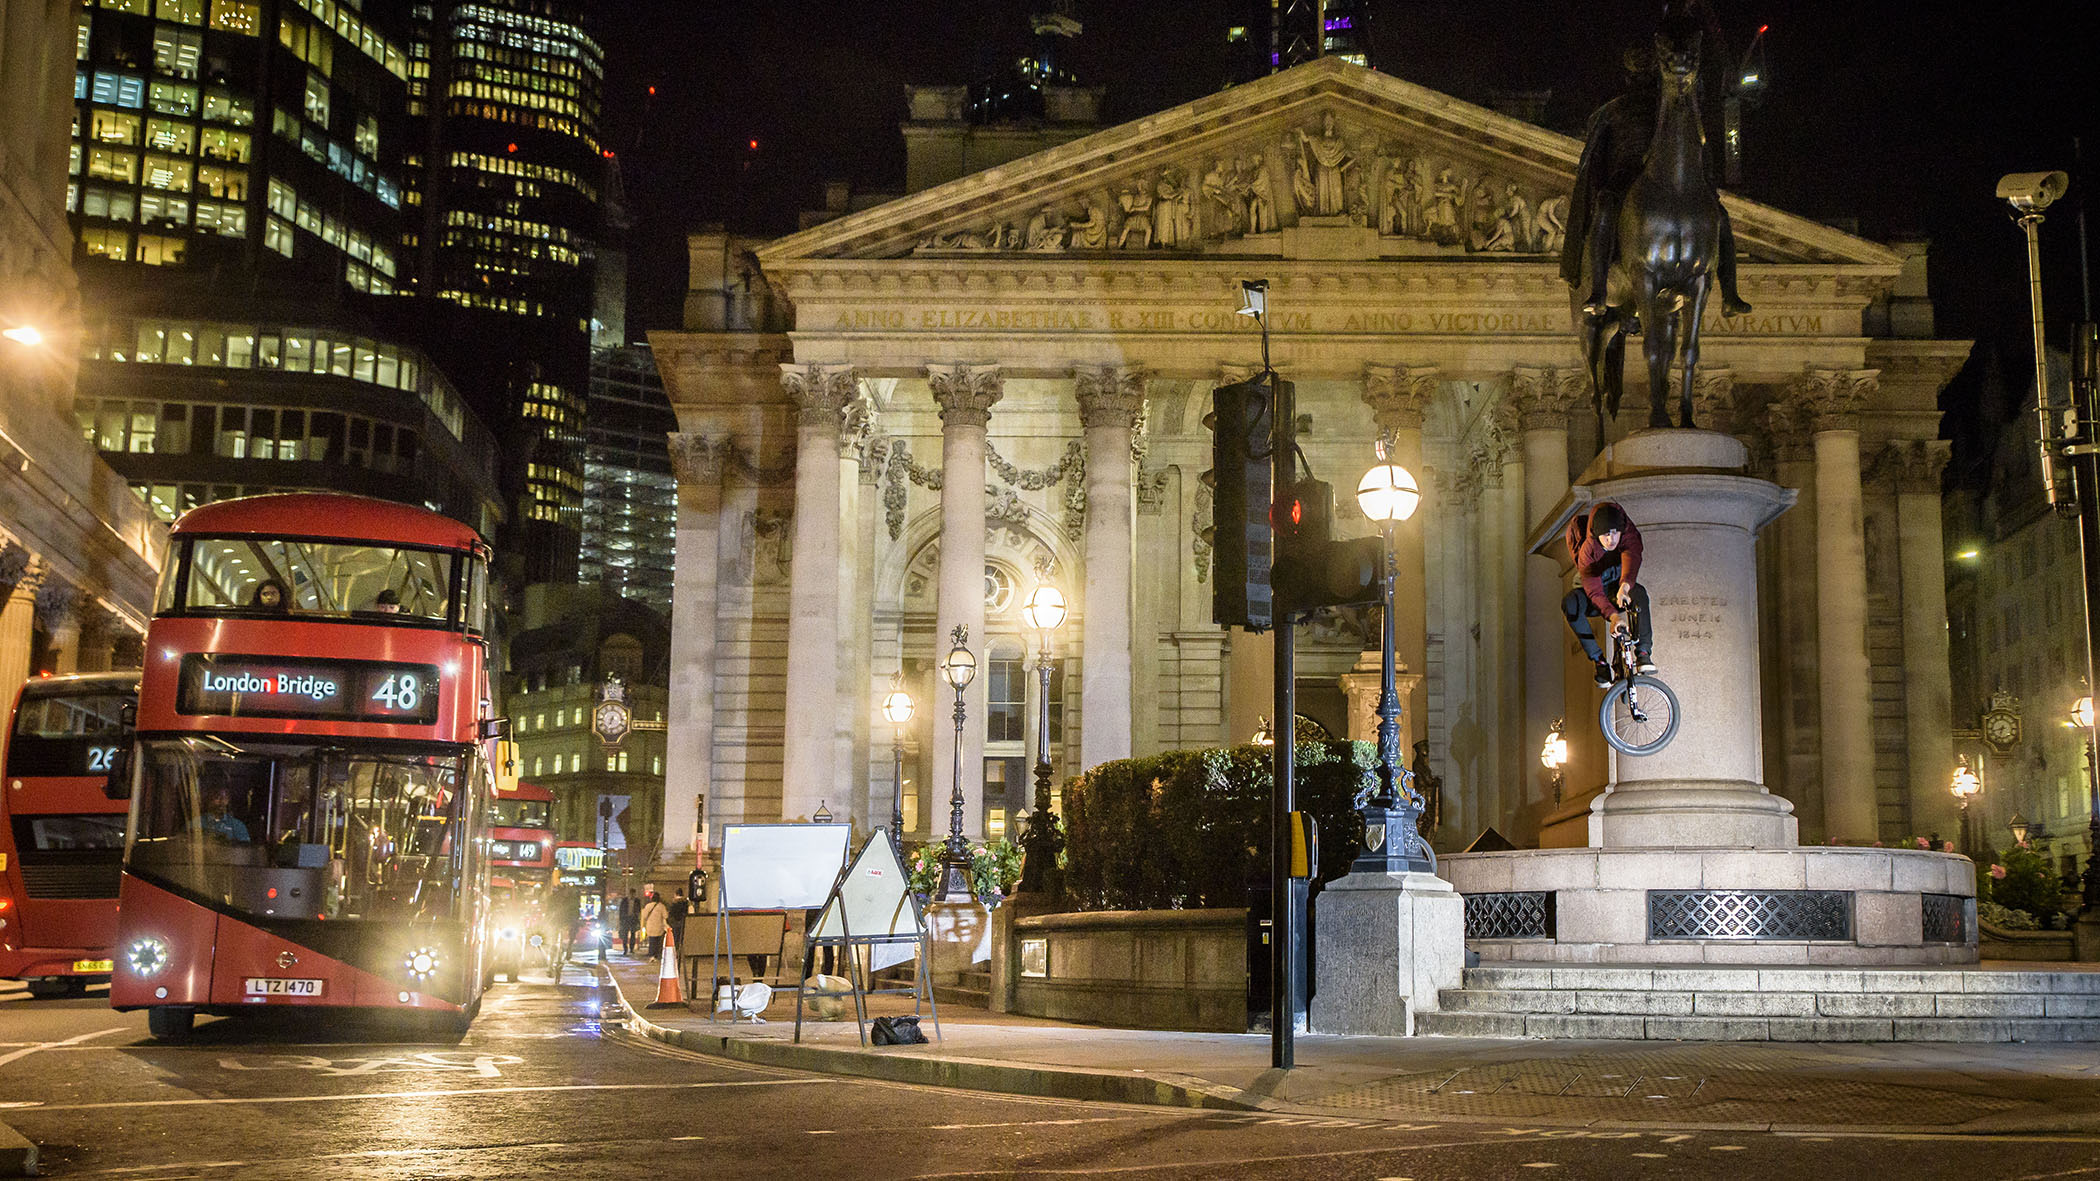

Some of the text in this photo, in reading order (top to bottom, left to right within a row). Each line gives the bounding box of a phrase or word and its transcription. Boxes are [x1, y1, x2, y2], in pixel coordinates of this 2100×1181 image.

[837, 310, 904, 328] ANNO
[922, 310, 1093, 329] ELIZABETHAE
[1111, 311, 1125, 329] R
[1344, 313, 1412, 331] ANNO
[1429, 313, 1555, 331] VICTORIAE
[1699, 314, 1822, 333] TAVRATVM
[1659, 596, 1728, 607] ERECTED
[1670, 613, 1707, 623] JUNE
[204, 671, 418, 710] London Bridge 48
[520, 844, 536, 858] 149
[255, 980, 314, 993] LTZ 1470
